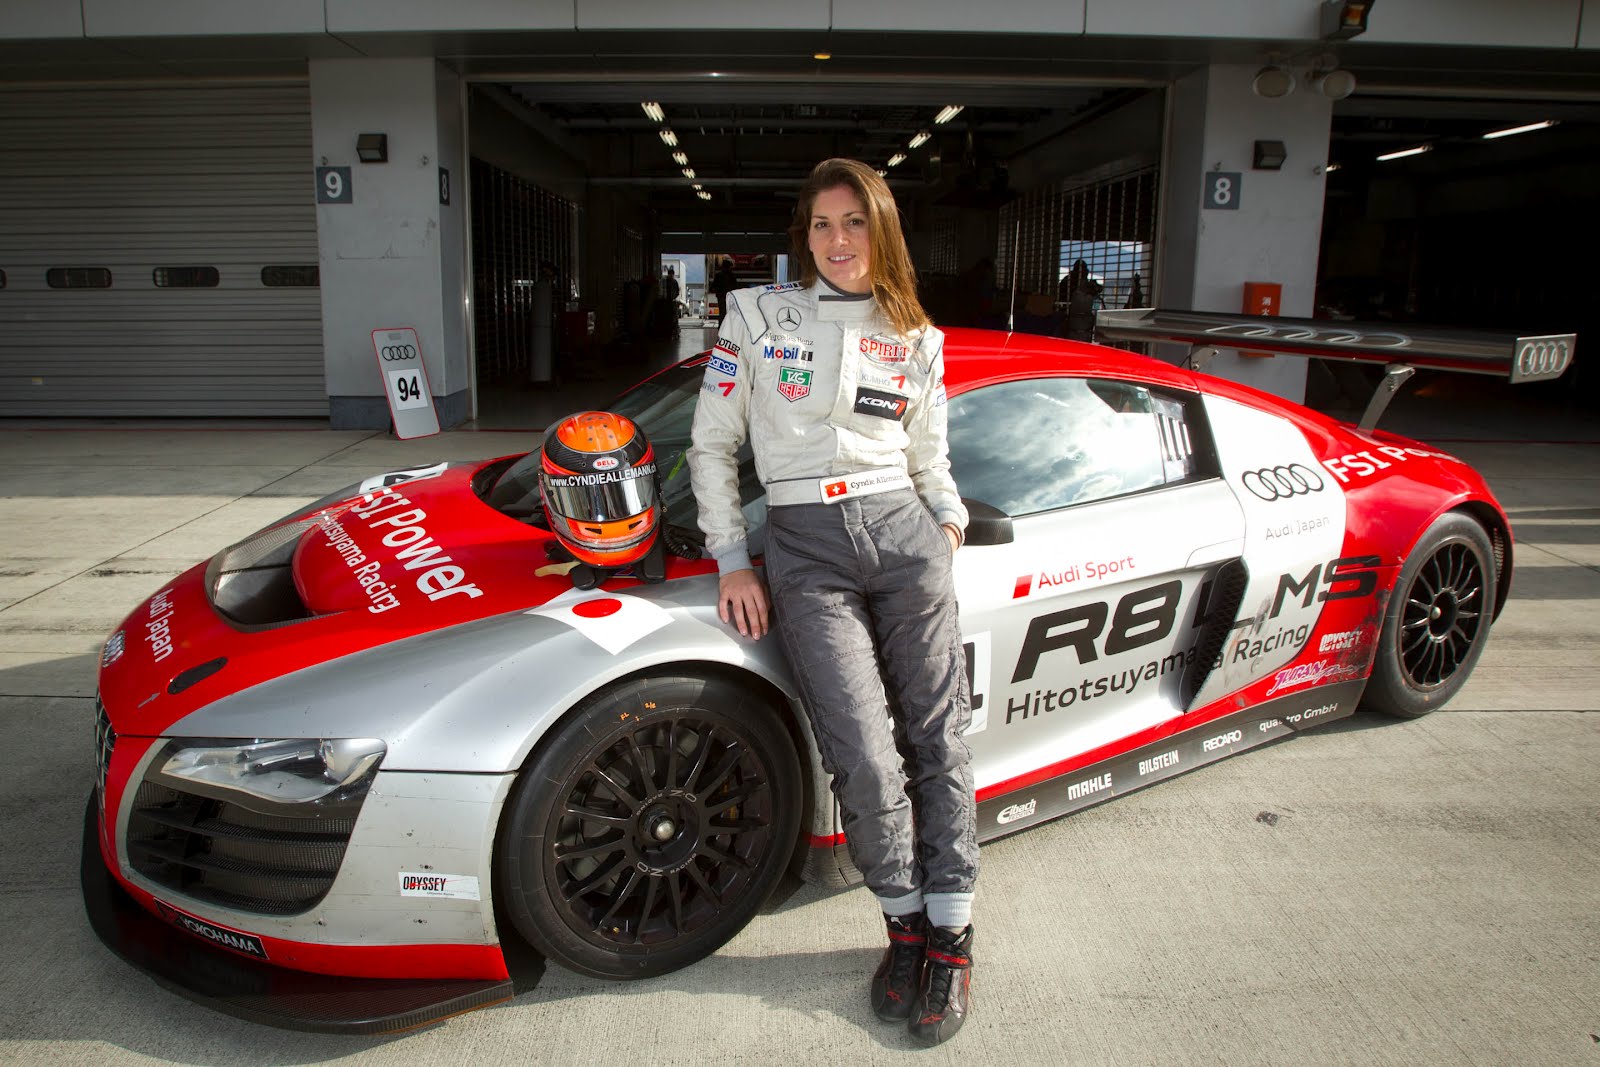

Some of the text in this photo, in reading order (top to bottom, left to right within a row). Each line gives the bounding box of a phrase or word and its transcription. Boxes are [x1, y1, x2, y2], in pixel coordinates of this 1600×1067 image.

[325, 171, 343, 199] 9
[441, 174, 448, 200] 8
[1214, 177, 1231, 205] 8
[765, 283, 793, 291] Mobil
[763, 345, 799, 360] Mobil
[860, 338, 910, 357] SPIRIT
[397, 376, 420, 402] 94
[786, 371, 806, 384] TAG
[780, 383, 808, 399] HEUER
[1322, 450, 1392, 483] FSI
[850, 480, 875, 489] Cyndie
[1265, 515, 1330, 541] Audi Japan
[368, 508, 484, 602] Power
[1038, 555, 1136, 589] Audi Sport
[353, 560, 400, 614] Racing
[144, 588, 174, 663] Audi Japan
[1010, 579, 1182, 684] R8
[1232, 622, 1309, 665] Racing
[1303, 702, 1338, 720] GmbH
[1203, 730, 1242, 752] RECARO
[1138, 750, 1179, 776] BILSTEIN
[1067, 773, 1112, 801] MAHLE
[997, 799, 1036, 824] Eibach
[403, 876, 447, 892] ODYSSEY
[182, 918, 260, 954] YOKOHAMA
